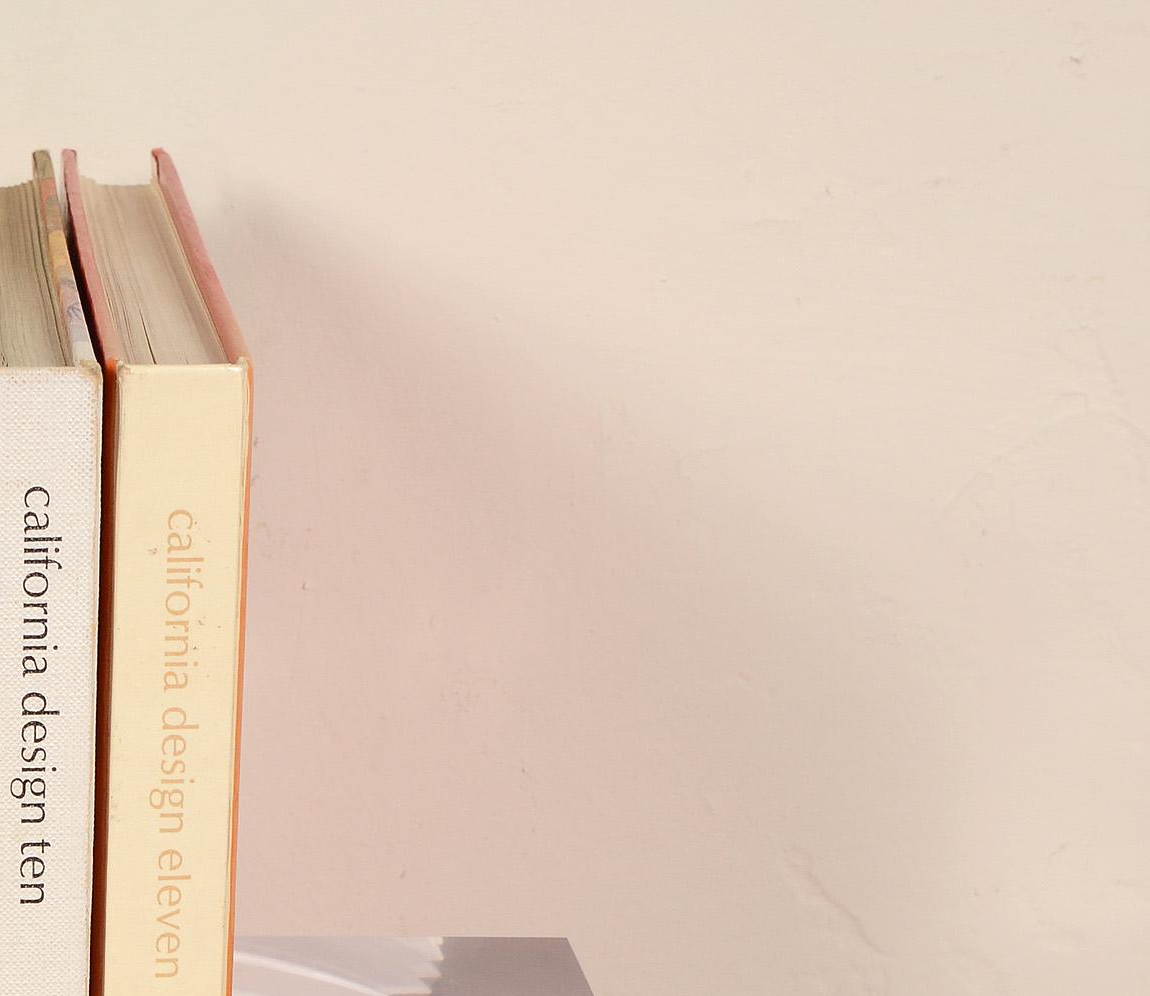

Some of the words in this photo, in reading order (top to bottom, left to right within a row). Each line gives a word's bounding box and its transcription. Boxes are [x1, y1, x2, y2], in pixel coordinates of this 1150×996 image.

[22, 486, 63, 678] california
[164, 509, 204, 691] california
[10, 691, 61, 824] design
[151, 707, 199, 833] design
[20, 838, 52, 905] ten
[156, 849, 192, 978] eleven
